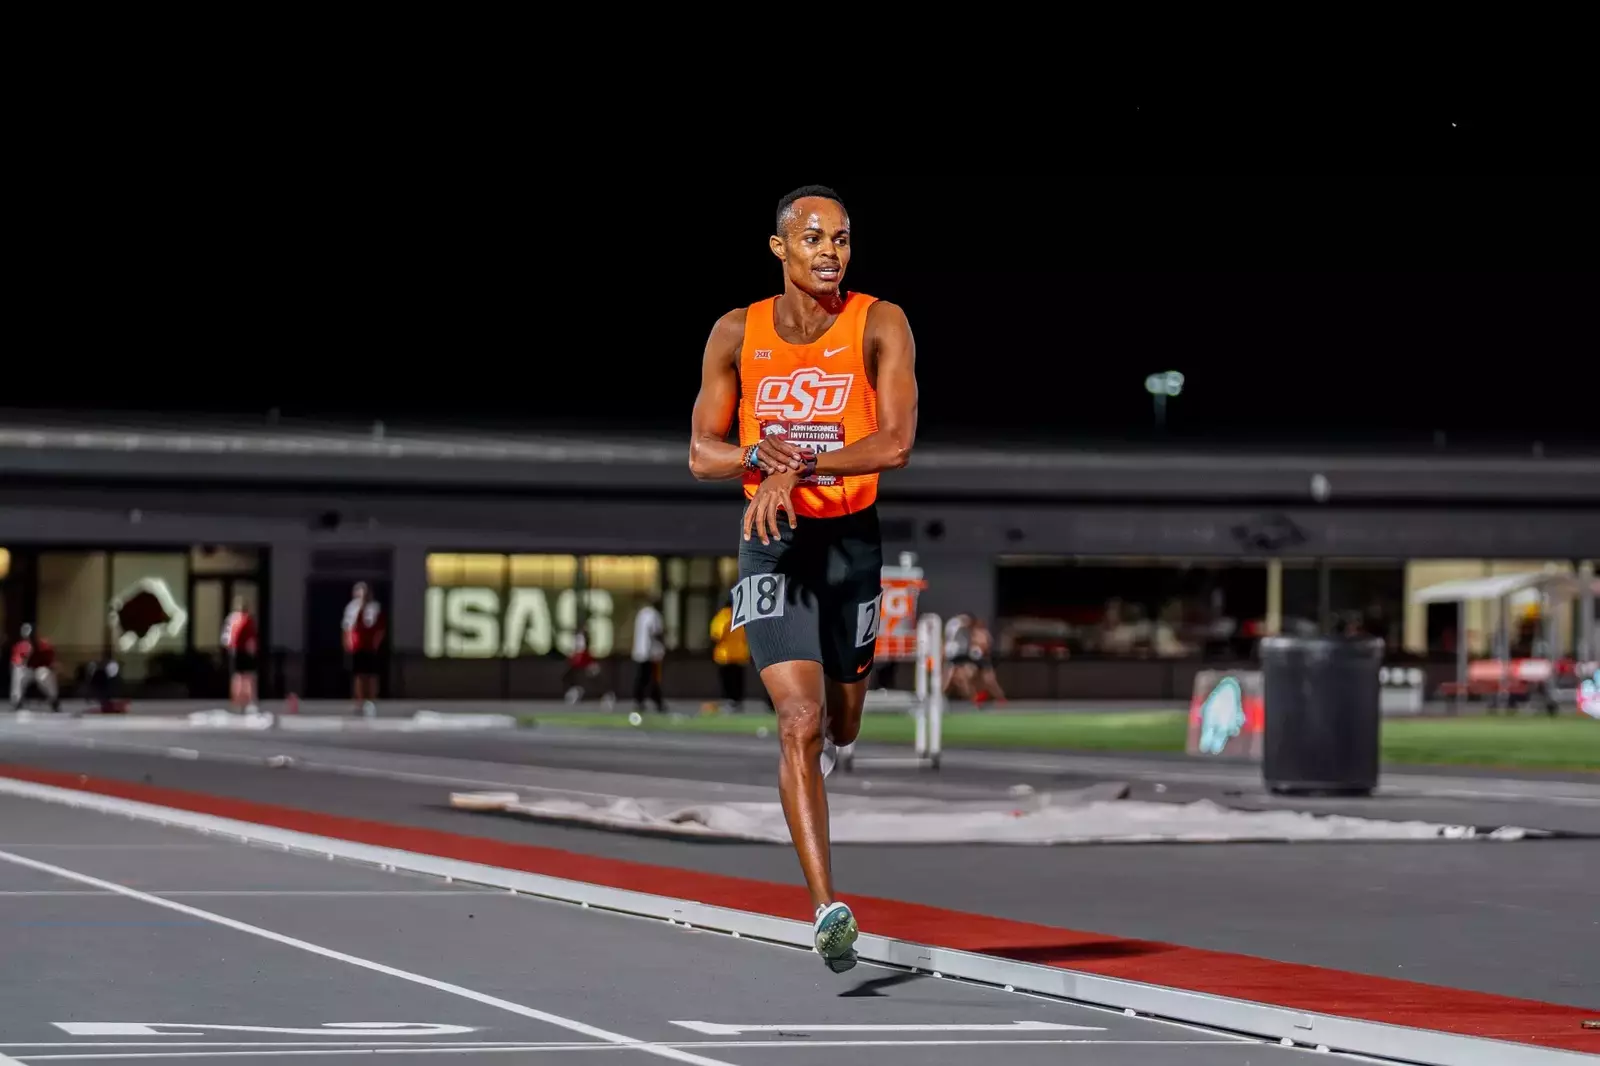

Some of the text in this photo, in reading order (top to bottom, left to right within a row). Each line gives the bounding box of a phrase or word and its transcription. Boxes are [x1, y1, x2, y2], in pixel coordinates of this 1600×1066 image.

[756, 368, 853, 421] OSU
[790, 432, 839, 440] INVITATIONAL
[734, 576, 777, 626] 28
